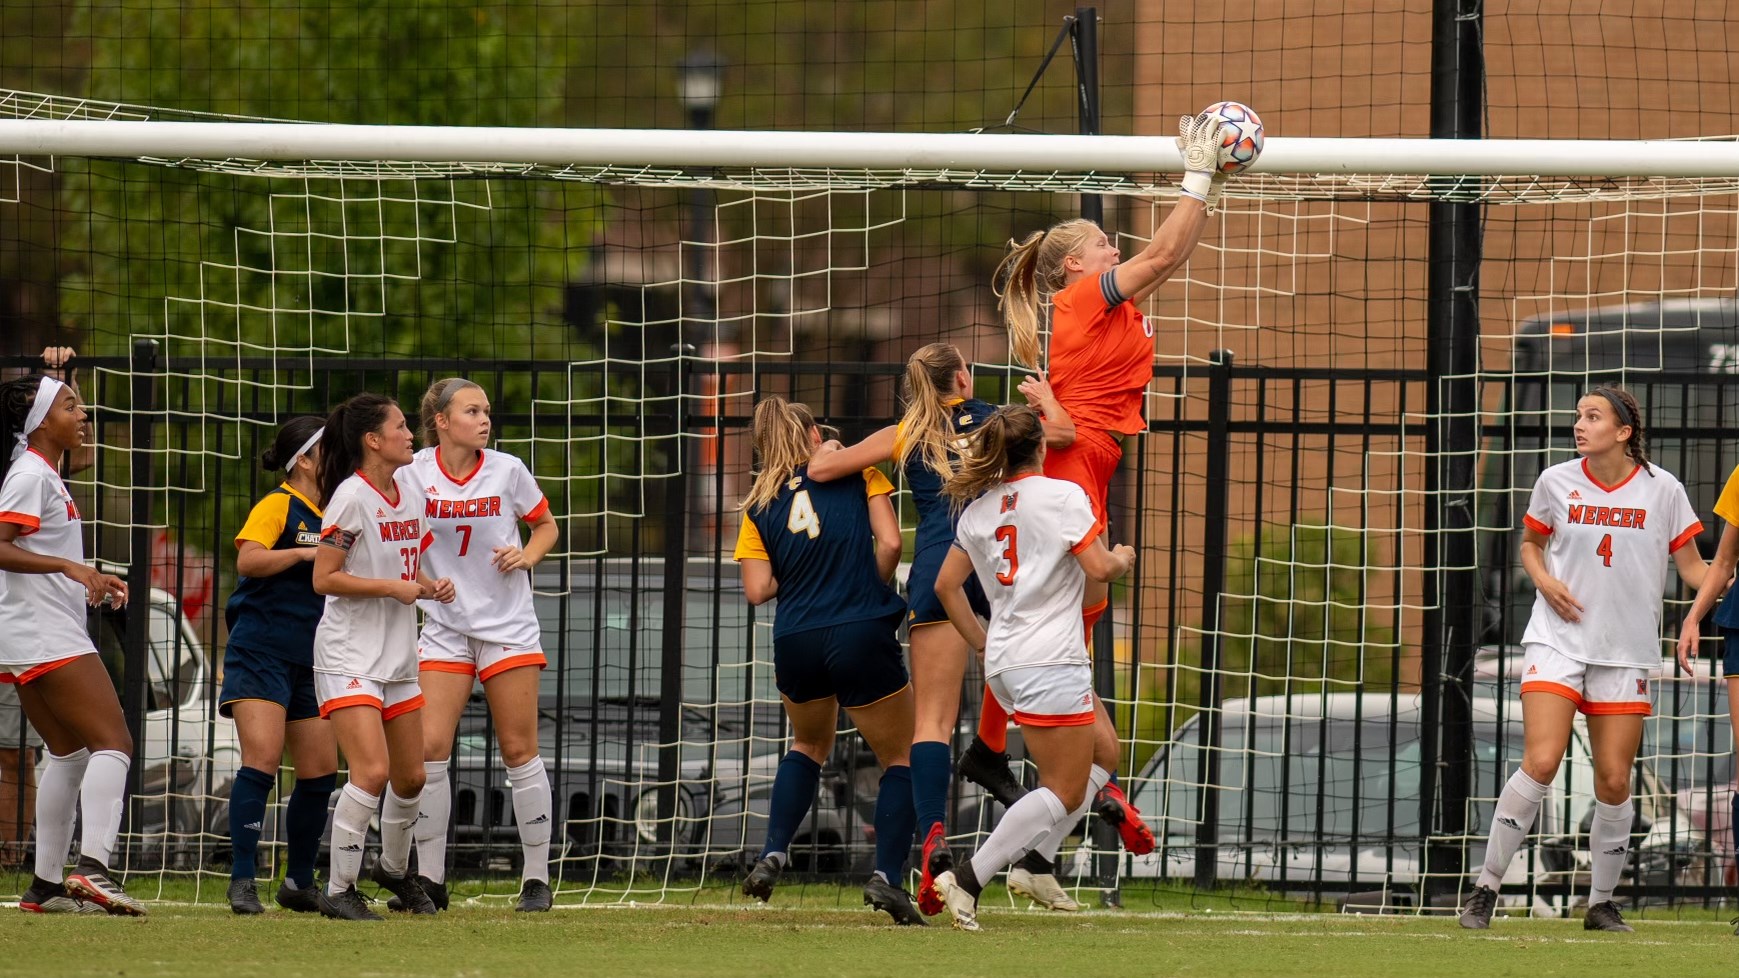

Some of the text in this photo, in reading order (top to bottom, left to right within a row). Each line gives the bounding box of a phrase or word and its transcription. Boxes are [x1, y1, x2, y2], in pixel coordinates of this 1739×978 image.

[425, 495, 501, 519] MERCER
[787, 489, 820, 540] 4
[1567, 503, 1647, 530] MERCER
[378, 518, 420, 542] MERCE
[456, 524, 472, 557] 7
[400, 546, 418, 581] 33
[995, 524, 1019, 587] 3
[1596, 533, 1613, 568] 4
